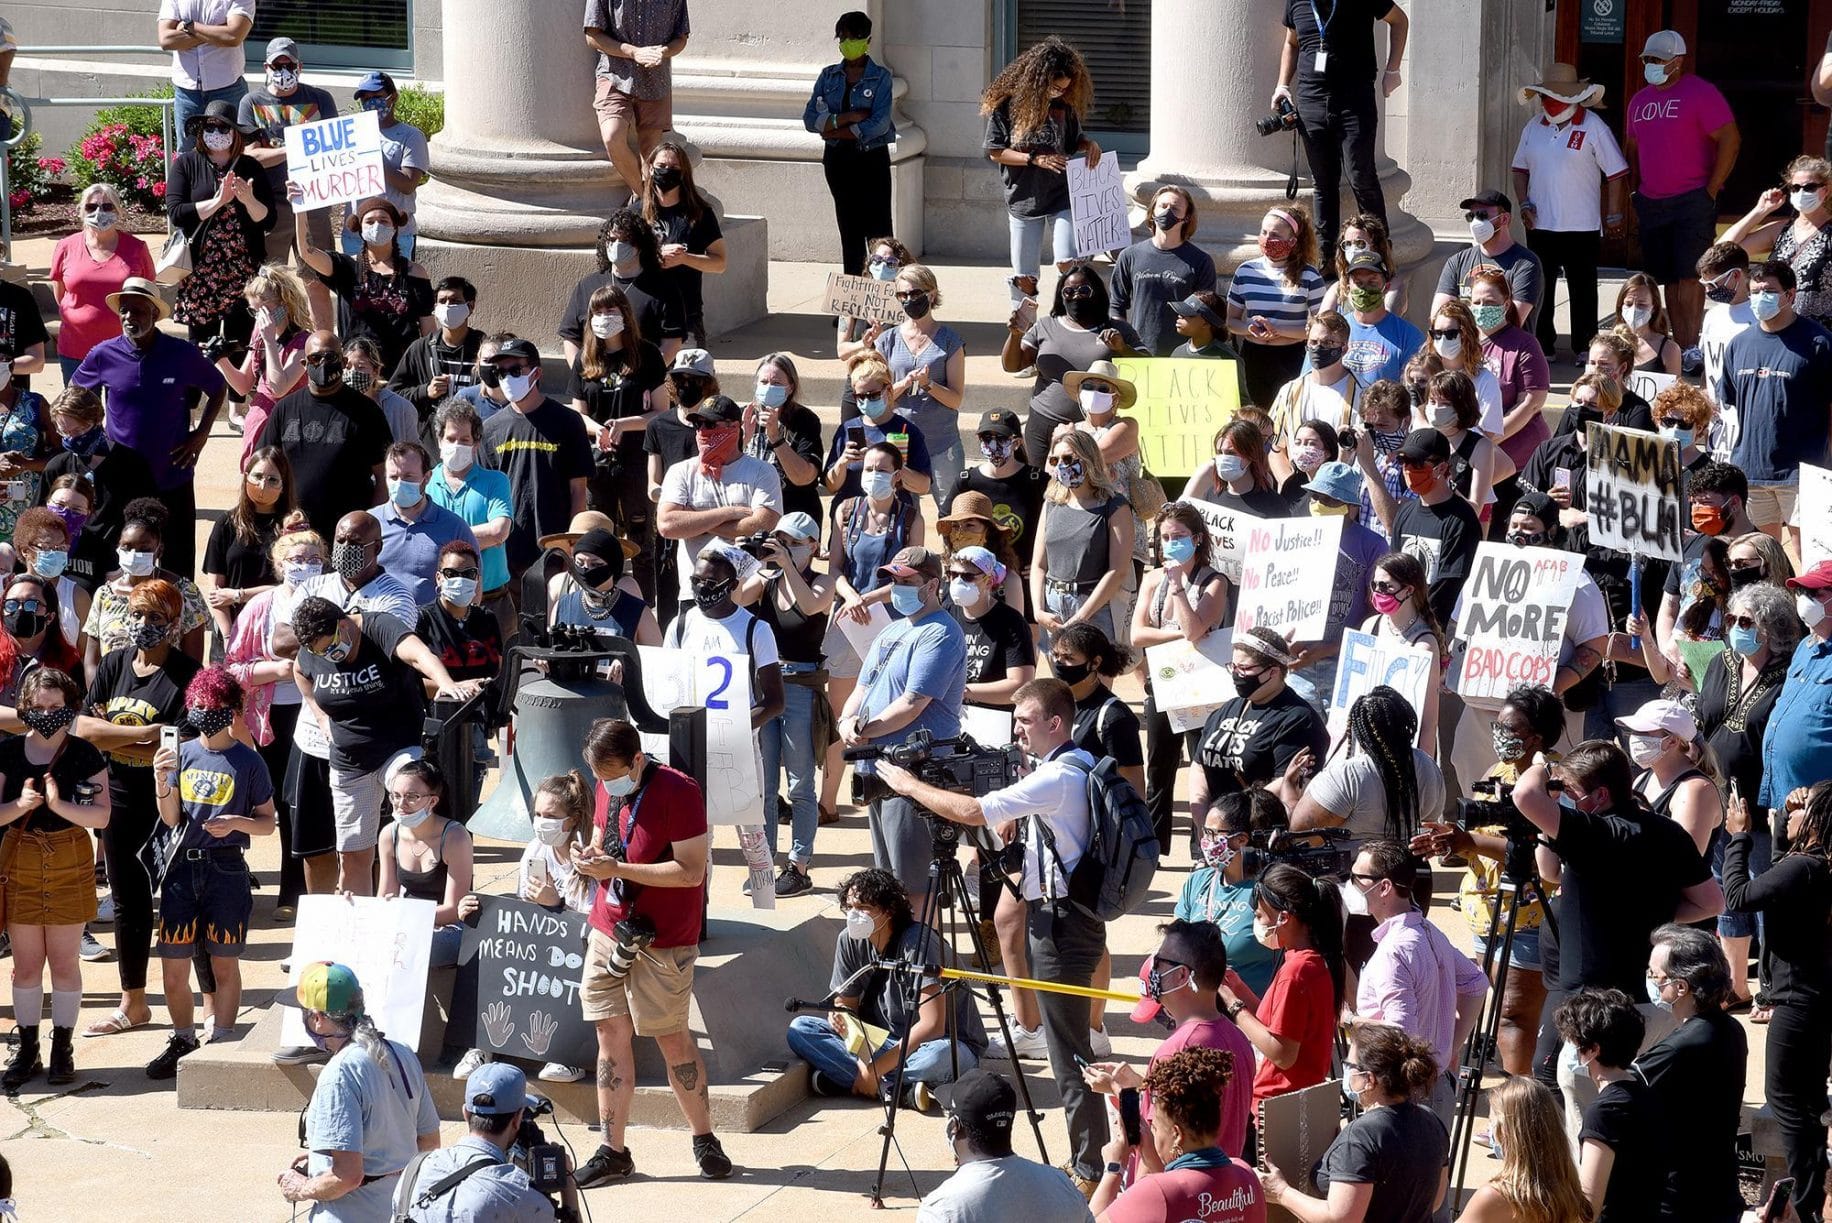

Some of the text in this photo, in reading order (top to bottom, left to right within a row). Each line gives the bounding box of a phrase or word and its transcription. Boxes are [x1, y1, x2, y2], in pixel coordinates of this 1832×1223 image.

[1633, 99, 1680, 122] LOVE
[302, 118, 356, 156] BLUE
[310, 150, 355, 172] LIVES
[301, 165, 385, 201] MURDER
[1071, 160, 1119, 193] BLACK
[1074, 185, 1121, 222] LIVES
[836, 275, 880, 293] Fighting
[831, 298, 905, 323] RESISTING
[864, 294, 889, 308] NOT
[1147, 404, 1213, 428] LIVES
[1588, 424, 1680, 498] MAMA
[1588, 480, 1680, 555] #BLM
[1275, 523, 1323, 551] Justice!!
[1265, 562, 1300, 588] Peace!!
[1472, 556, 1531, 604] NO
[1256, 605, 1284, 627] Racist
[1286, 598, 1322, 623] Police!!
[313, 664, 380, 693] JUSTICE
[1465, 647, 1553, 685] BAD COPS
[705, 656, 733, 710] 2
[497, 909, 568, 938] HANDS
[478, 937, 537, 962] MEANS
[502, 966, 581, 1005] SHOOT
[1197, 1184, 1256, 1218] Beautiful
